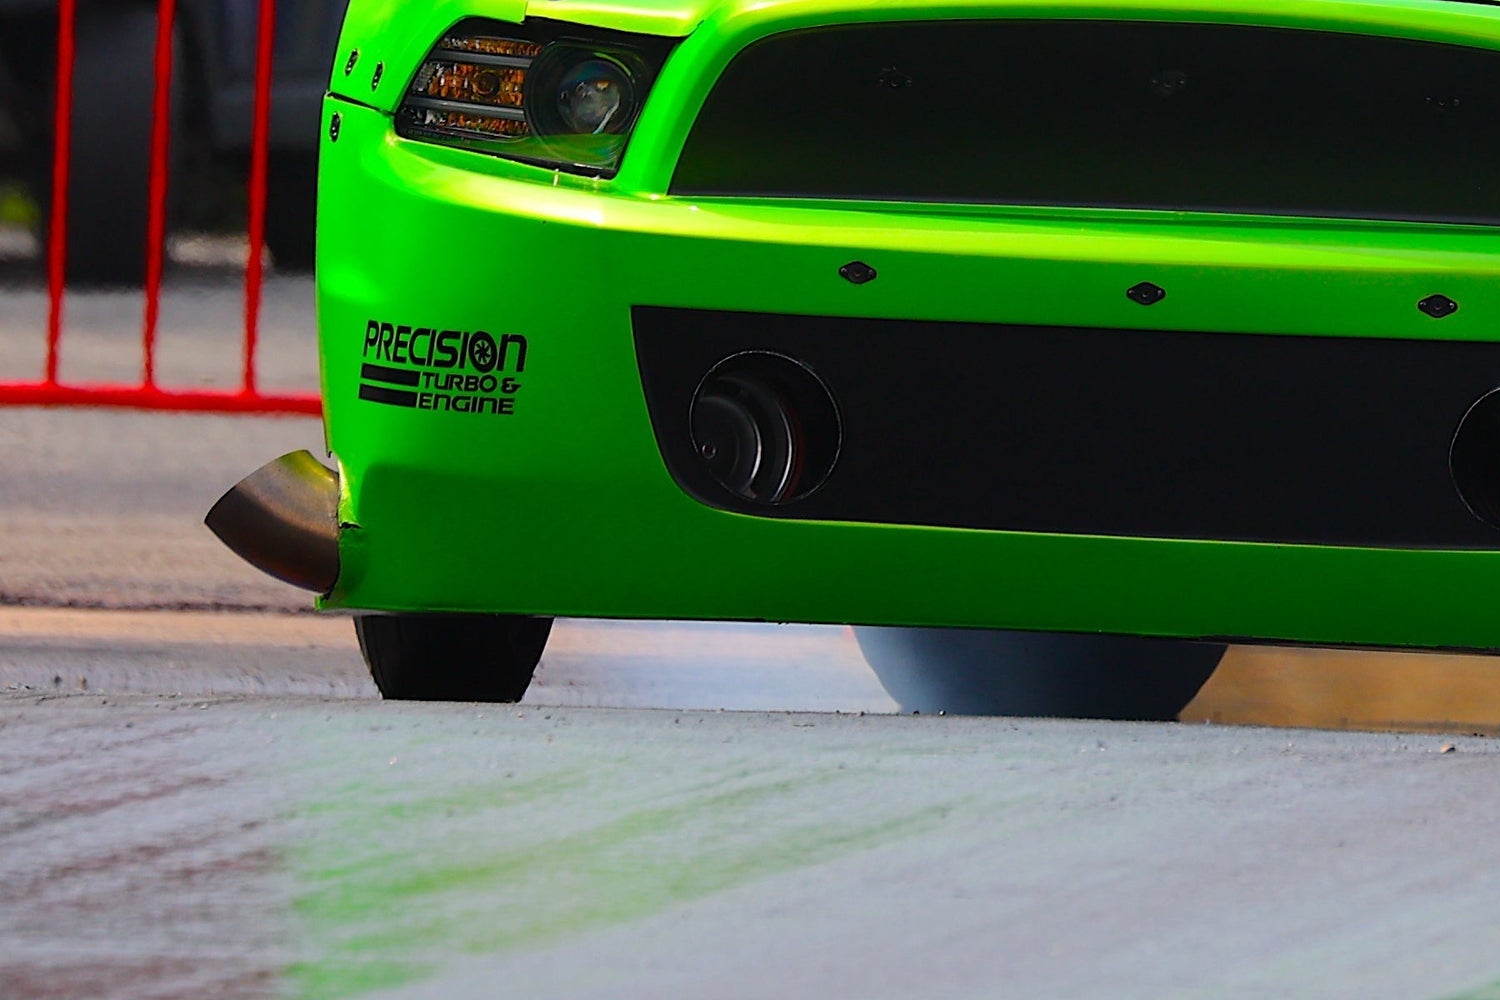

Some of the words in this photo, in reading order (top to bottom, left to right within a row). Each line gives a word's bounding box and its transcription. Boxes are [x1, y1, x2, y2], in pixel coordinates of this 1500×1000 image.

[363, 320, 528, 374] PRECISION
[422, 371, 498, 394] TURBO
[500, 377, 521, 394] &
[416, 392, 515, 415] ENGINE
